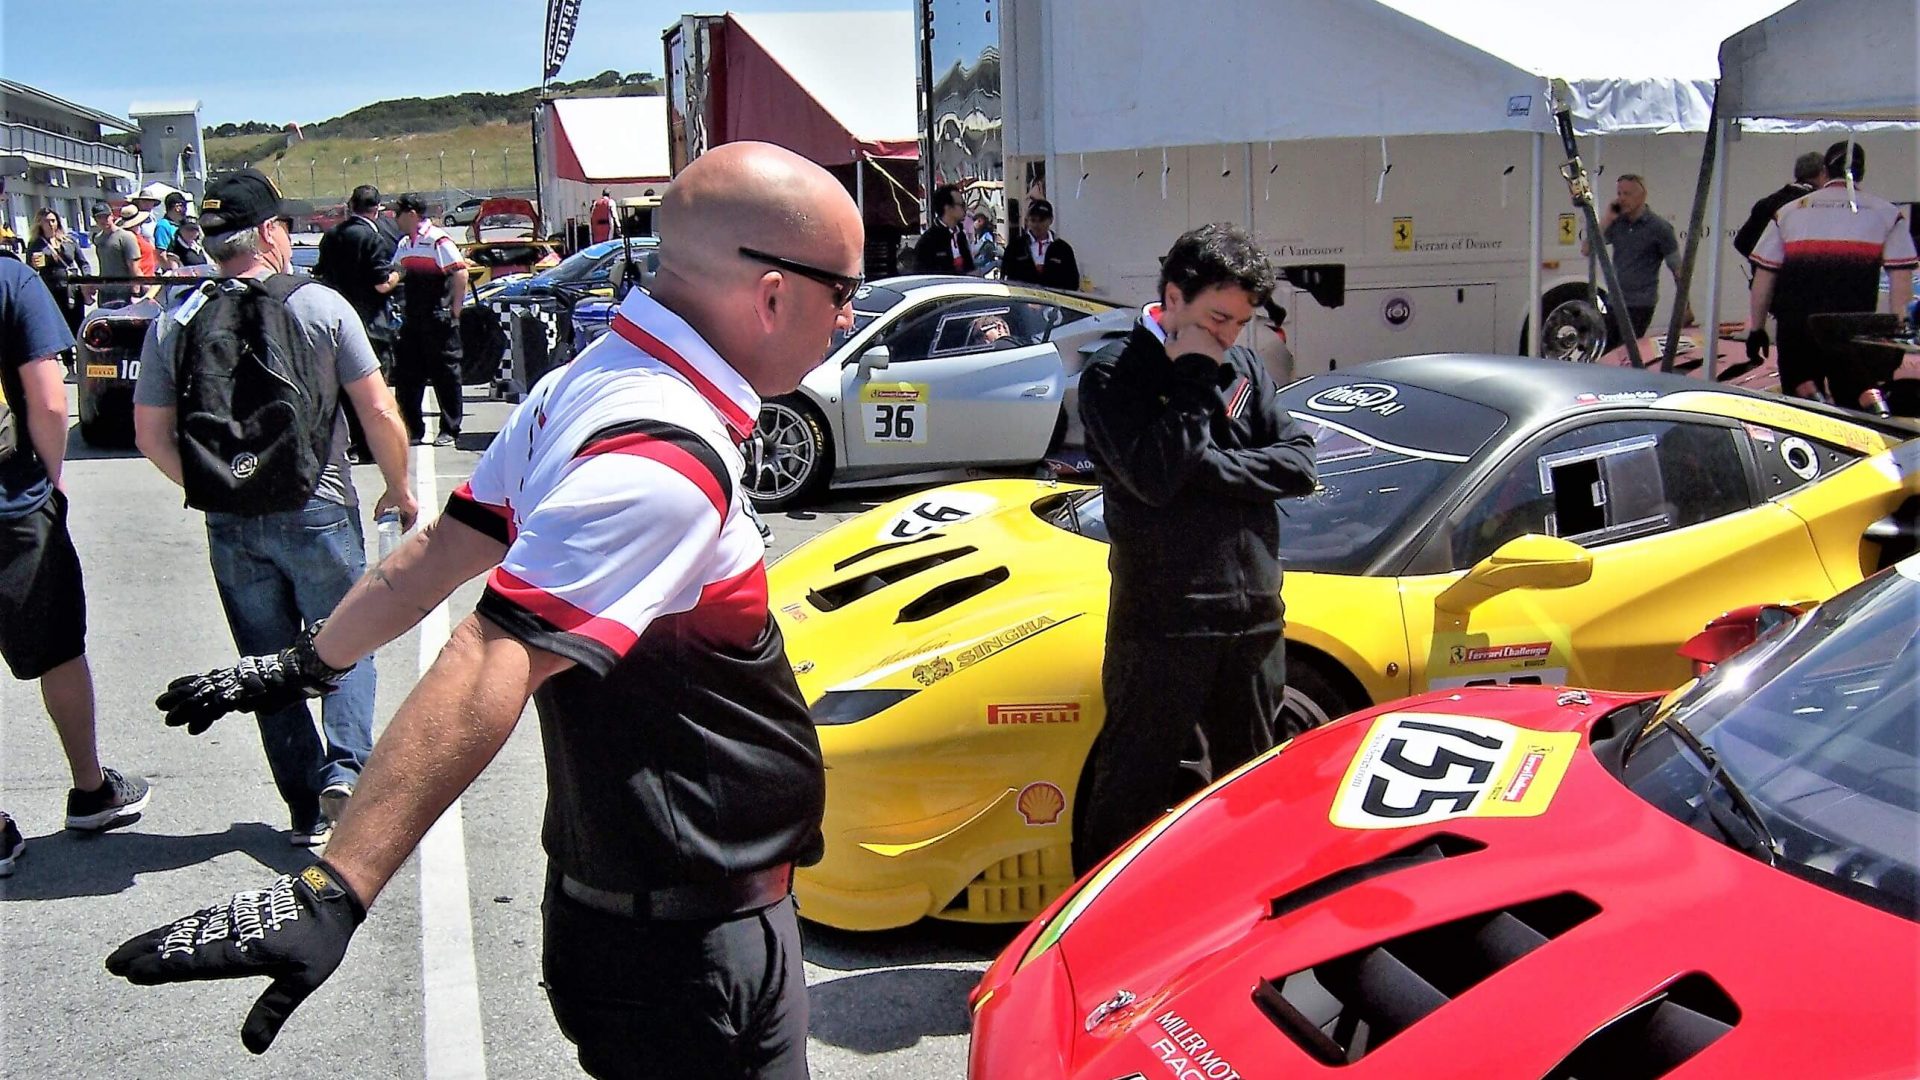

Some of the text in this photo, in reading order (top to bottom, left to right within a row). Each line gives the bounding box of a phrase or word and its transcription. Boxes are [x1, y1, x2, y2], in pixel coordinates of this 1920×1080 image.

[553, 0, 576, 65] Ferra
[1274, 245, 1344, 257] of Vancouver
[1414, 238, 1503, 252] Ferrari of Denver
[874, 404, 915, 438] 36
[956, 615, 1056, 668] SINGHA
[988, 703, 1080, 725] PIRELLI
[1361, 720, 1504, 819] 155
[1155, 1010, 1207, 1056] MILLER
